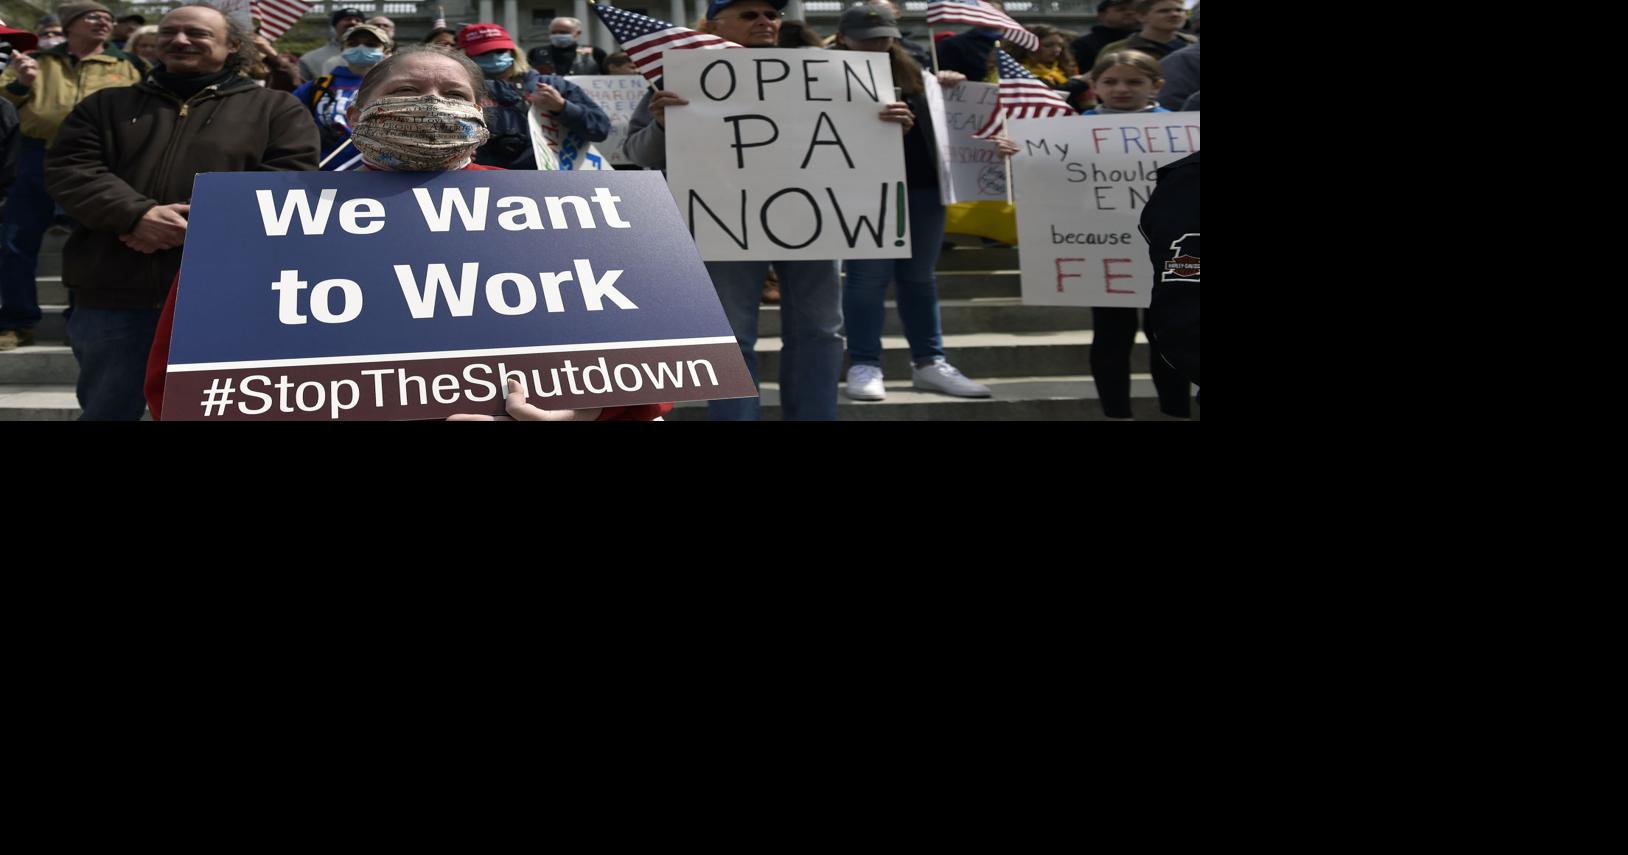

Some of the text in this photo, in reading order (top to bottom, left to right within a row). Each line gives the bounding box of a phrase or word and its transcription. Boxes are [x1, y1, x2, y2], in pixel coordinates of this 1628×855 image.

[700, 58, 879, 102] OPEN
[723, 111, 856, 169] PA
[1025, 138, 1069, 162] My
[1066, 160, 1158, 183] Should
[256, 187, 631, 236] We Want
[689, 181, 906, 249] NOW!
[1051, 224, 1132, 246] because
[271, 258, 639, 325] to Work
[201, 357, 719, 418] #StopTheShutdown
